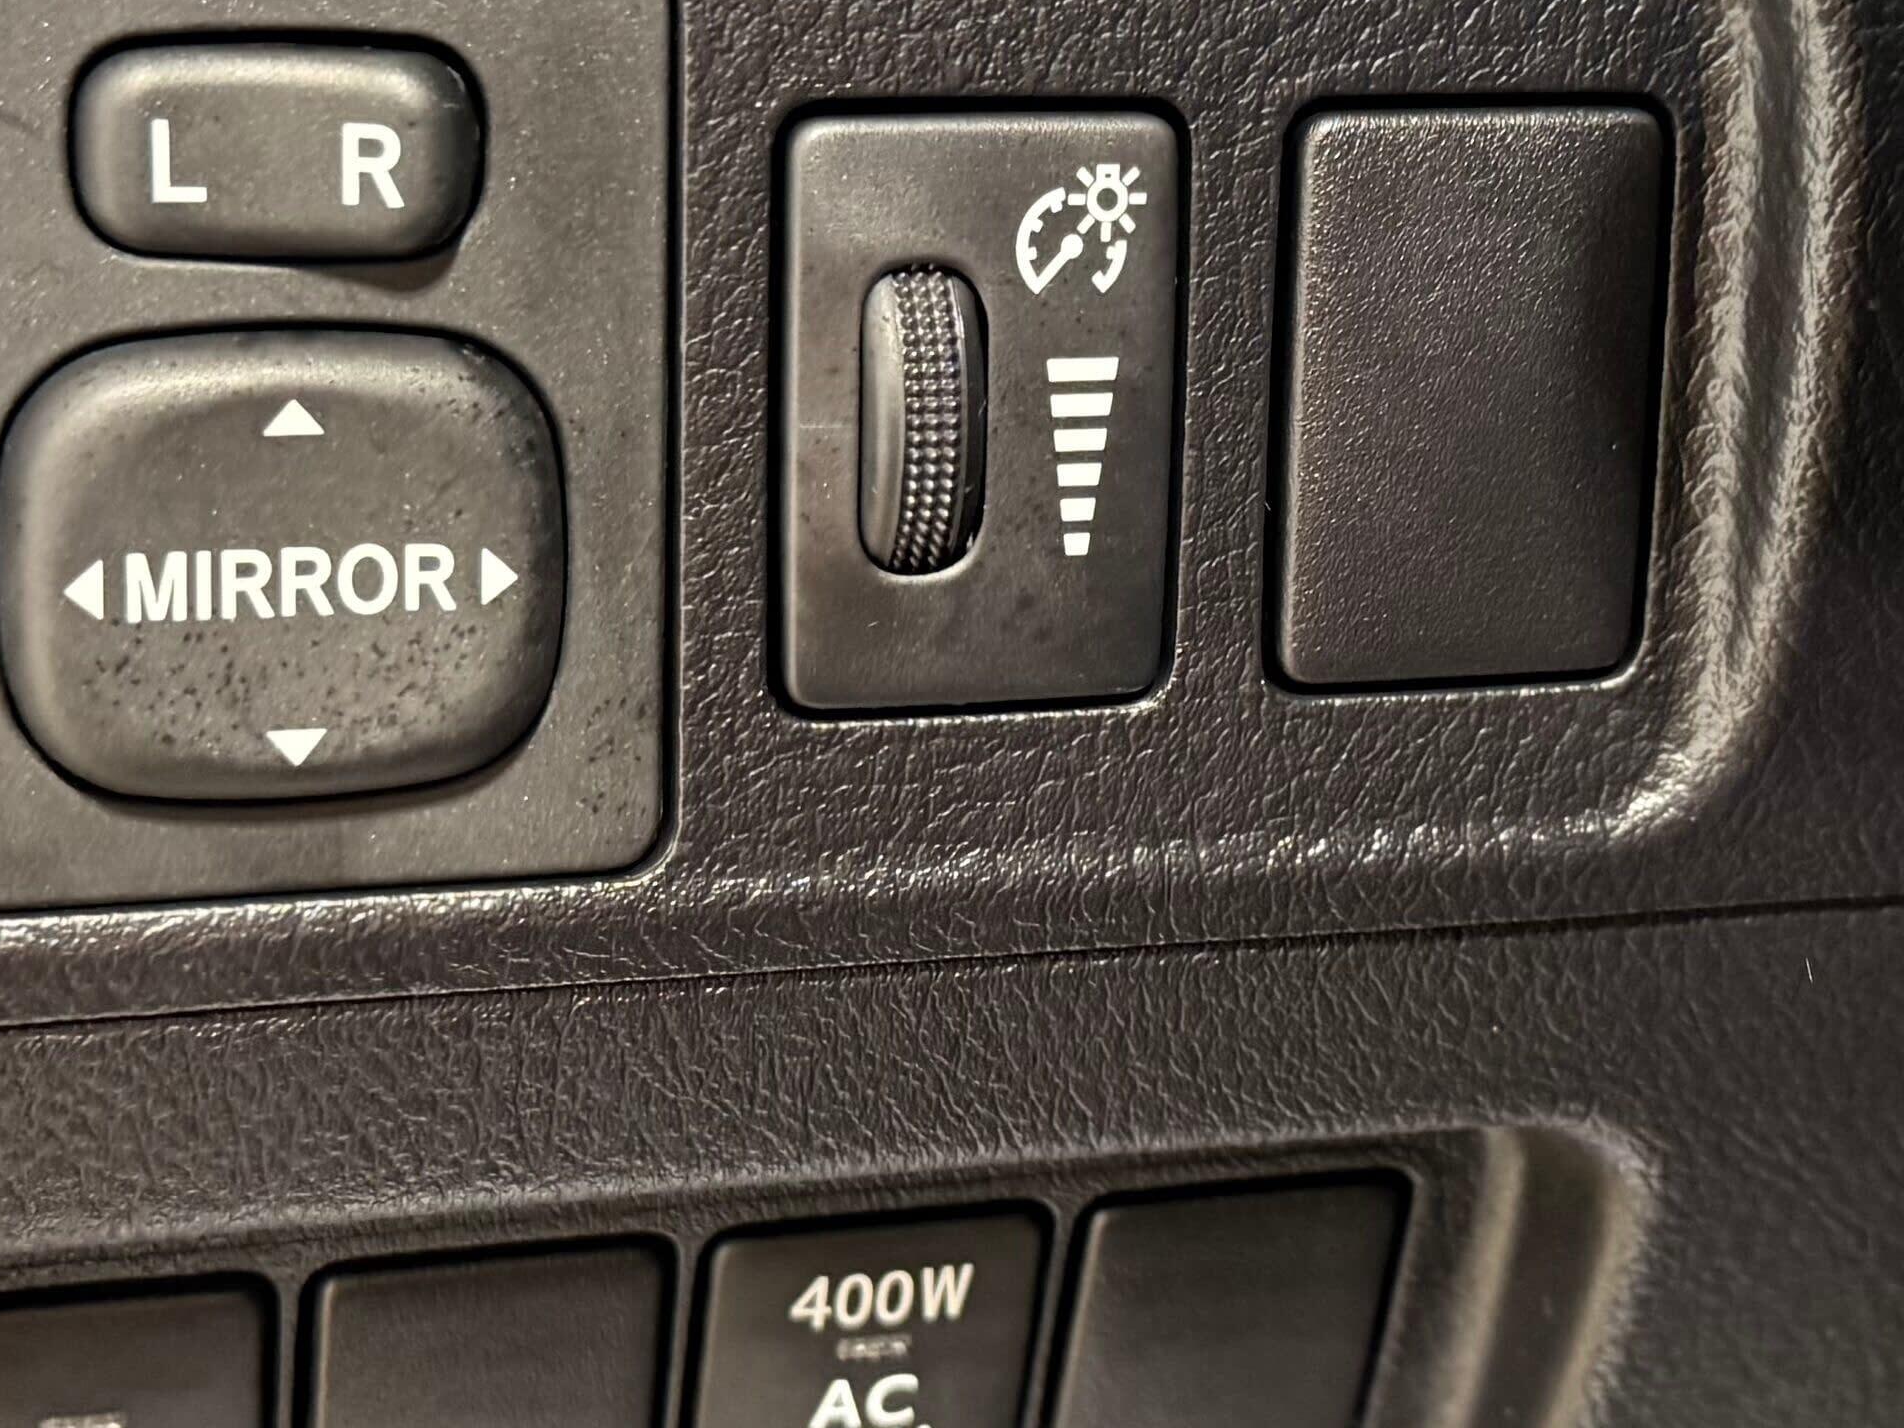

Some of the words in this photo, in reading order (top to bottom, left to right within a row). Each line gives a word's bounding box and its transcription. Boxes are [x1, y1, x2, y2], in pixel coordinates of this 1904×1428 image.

[151, 117, 208, 204] L
[340, 122, 406, 209] R
[124, 543, 457, 623] MIRROR
[788, 1262, 975, 1332] 400W
